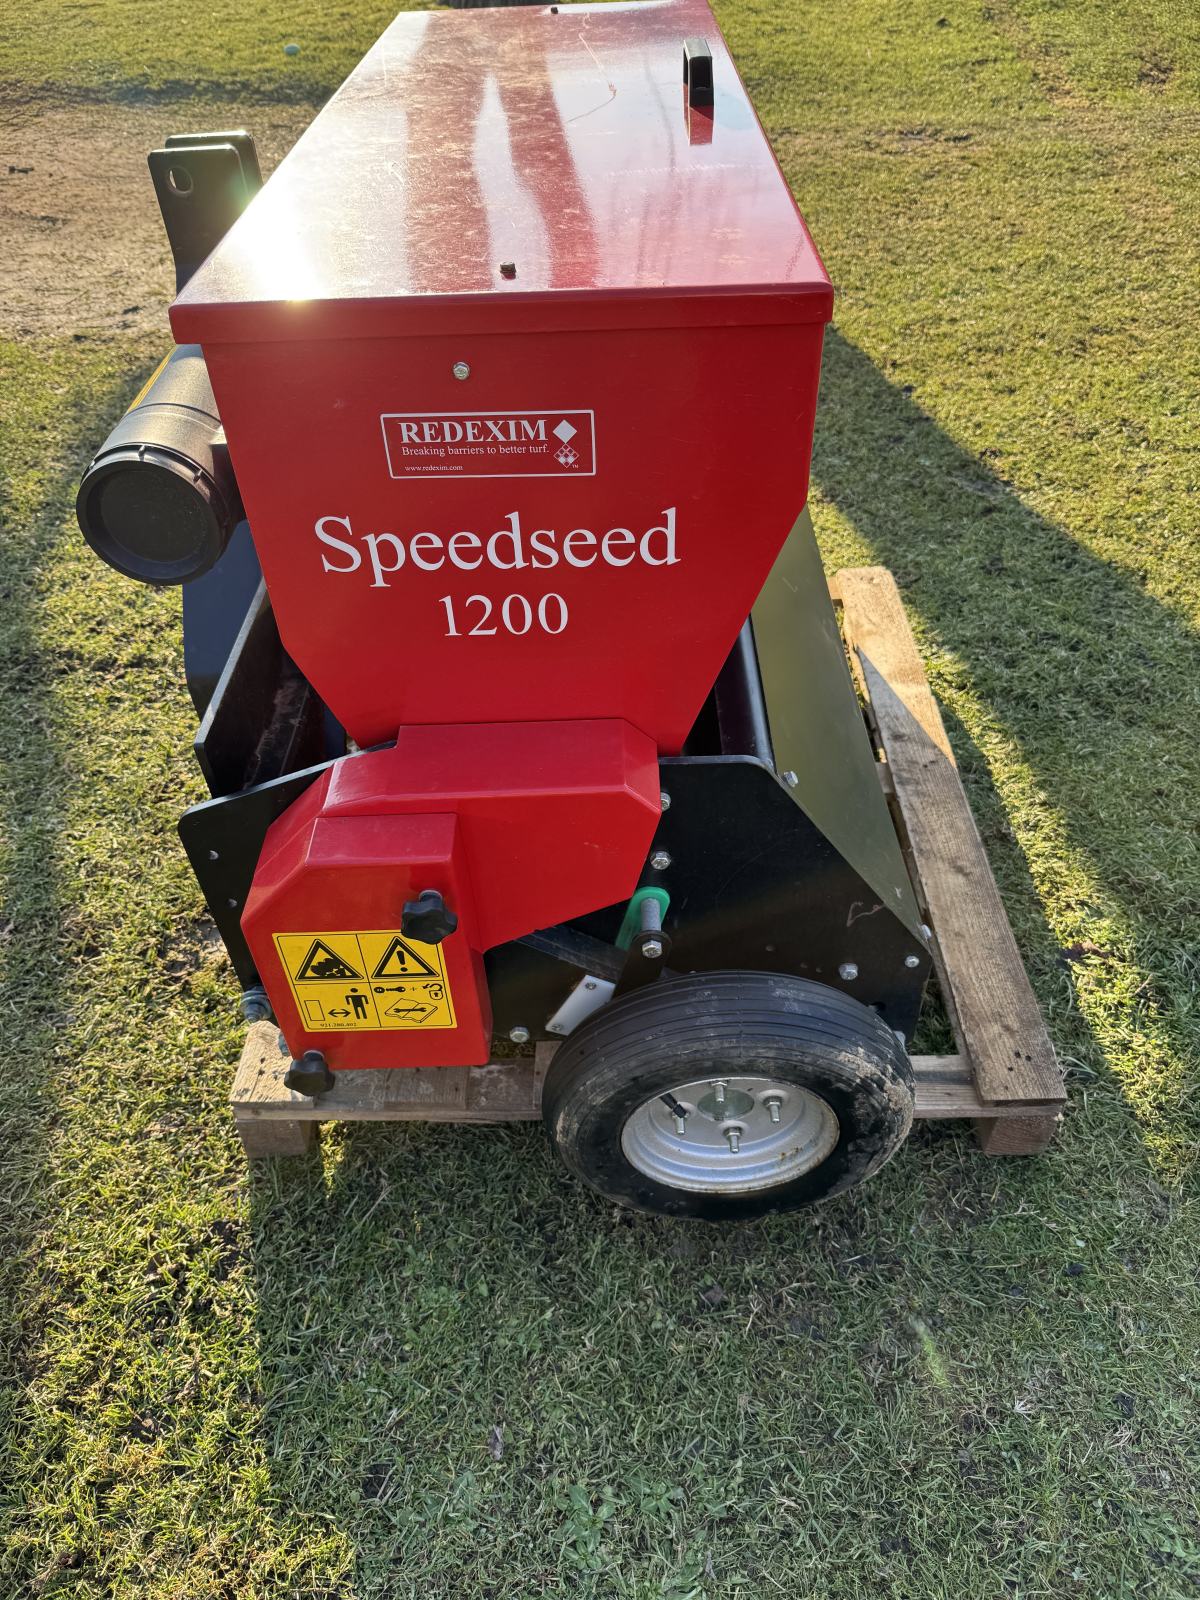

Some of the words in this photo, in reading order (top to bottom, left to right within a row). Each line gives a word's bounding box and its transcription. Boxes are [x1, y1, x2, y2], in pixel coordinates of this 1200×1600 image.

[399, 419, 548, 443] REDEXIM
[402, 446, 446, 457] Breaking
[448, 445, 484, 455] barriers
[487, 446, 497, 454] to
[499, 445, 527, 454] better
[529, 444, 550, 453] turf.
[314, 506, 682, 588] Speedseed
[438, 592, 569, 637] 1200
